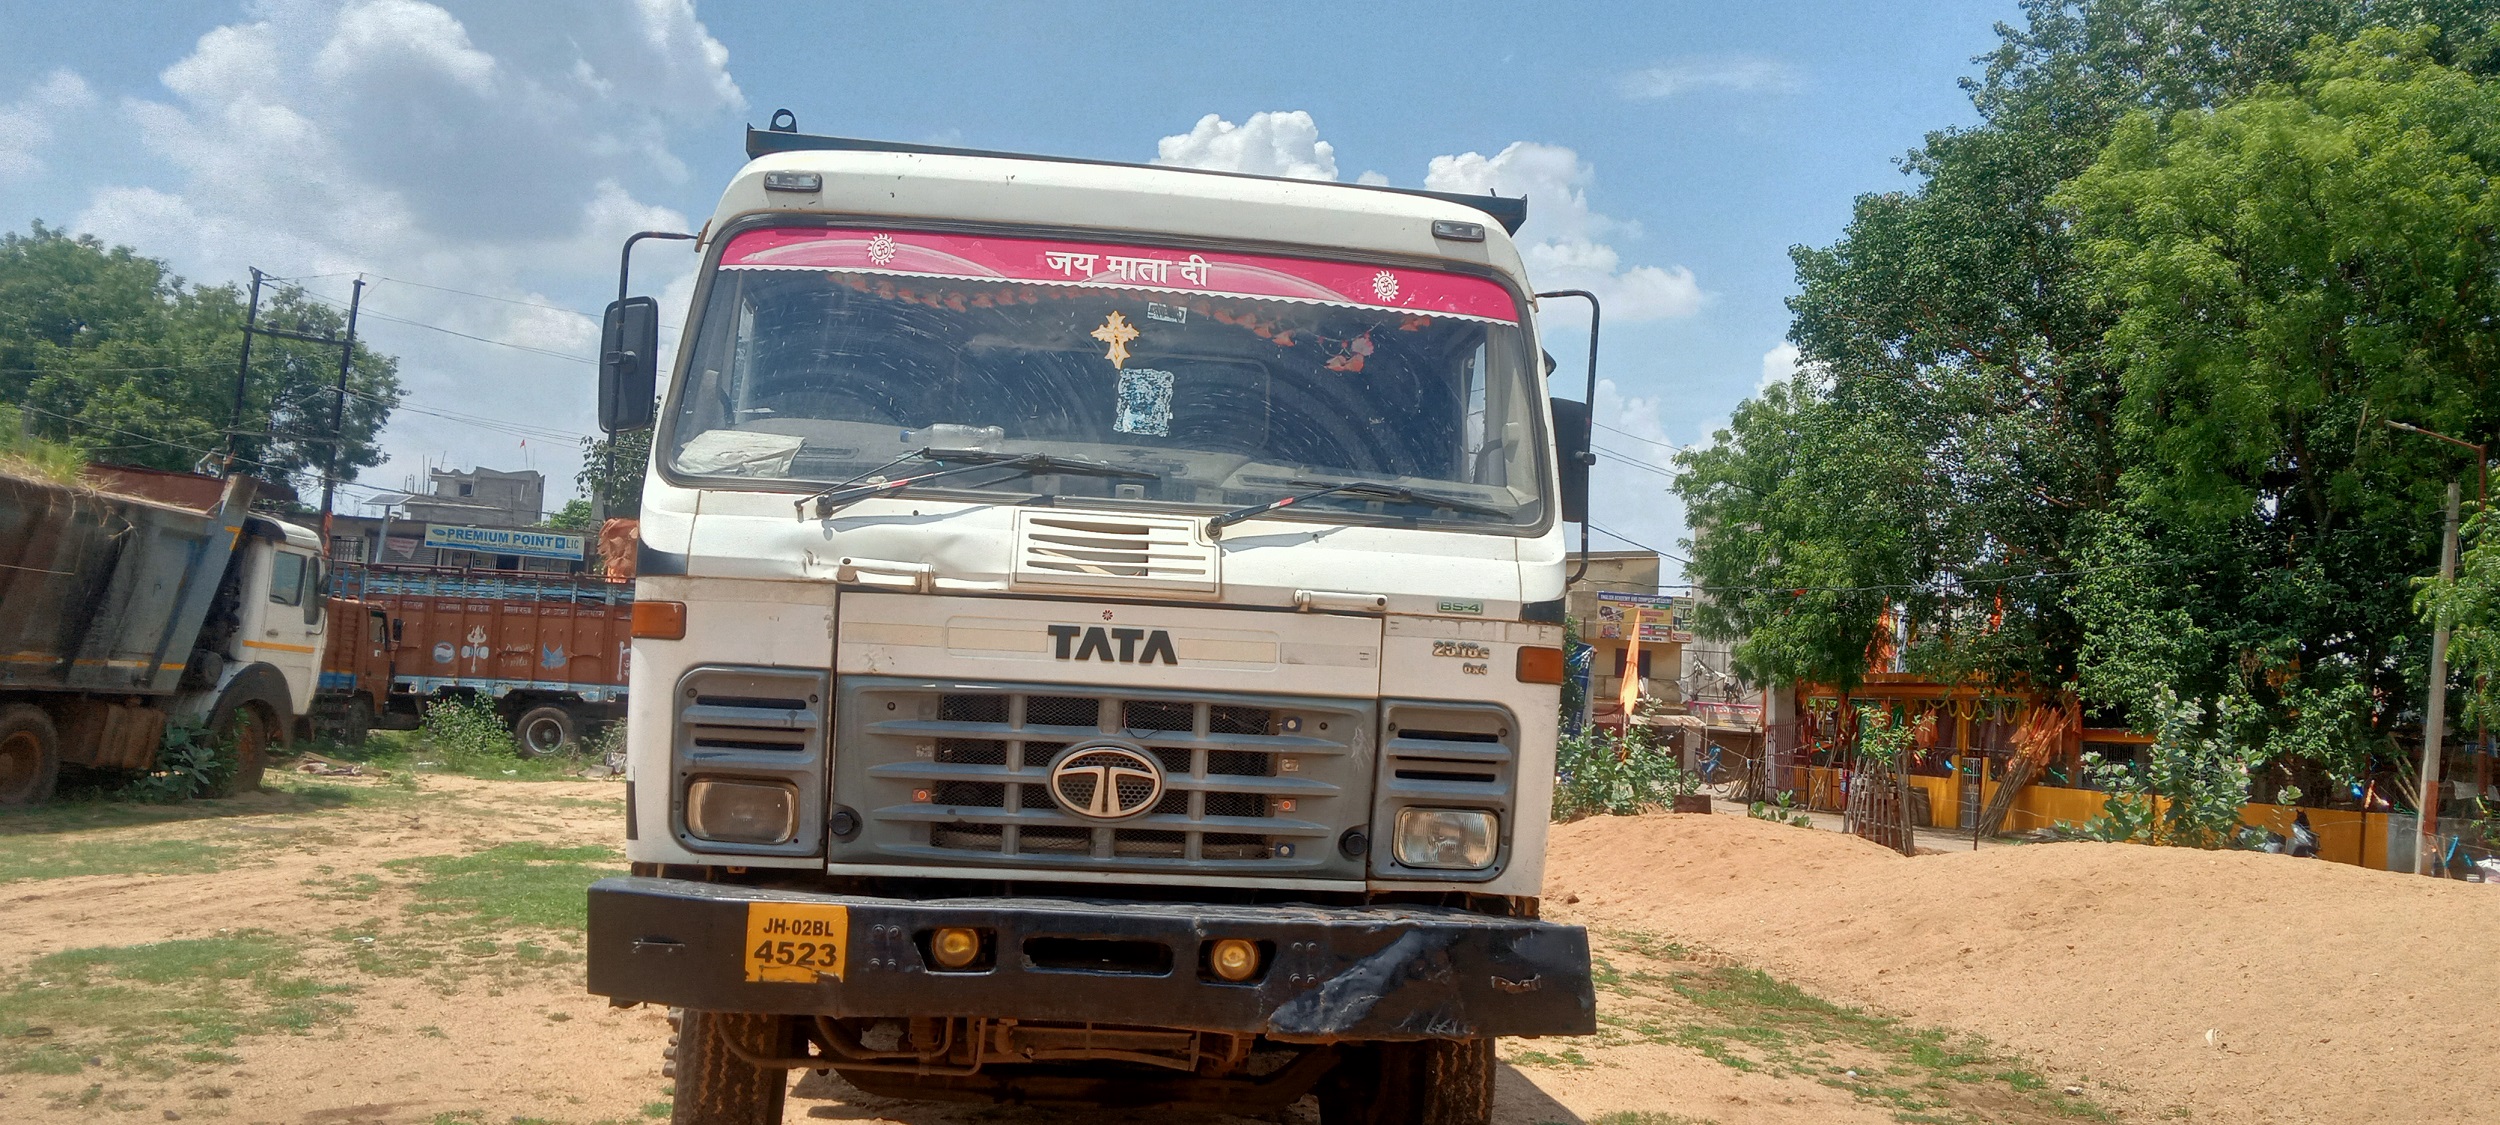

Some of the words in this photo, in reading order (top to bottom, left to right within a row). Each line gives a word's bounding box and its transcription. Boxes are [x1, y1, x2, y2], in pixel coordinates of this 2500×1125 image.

[1045, 251, 1099, 278] जय
[1106, 255, 1173, 284] माता
[1178, 254, 1212, 287] दी
[447, 528, 509, 544] PREMIUM
[513, 534, 553, 547] POINT
[565, 539, 579, 549] LIC
[1440, 602, 1480, 612] BS-4
[1048, 625, 1178, 665] TATA
[763, 918, 834, 937] JH-02BL
[754, 940, 837, 967] 4523
